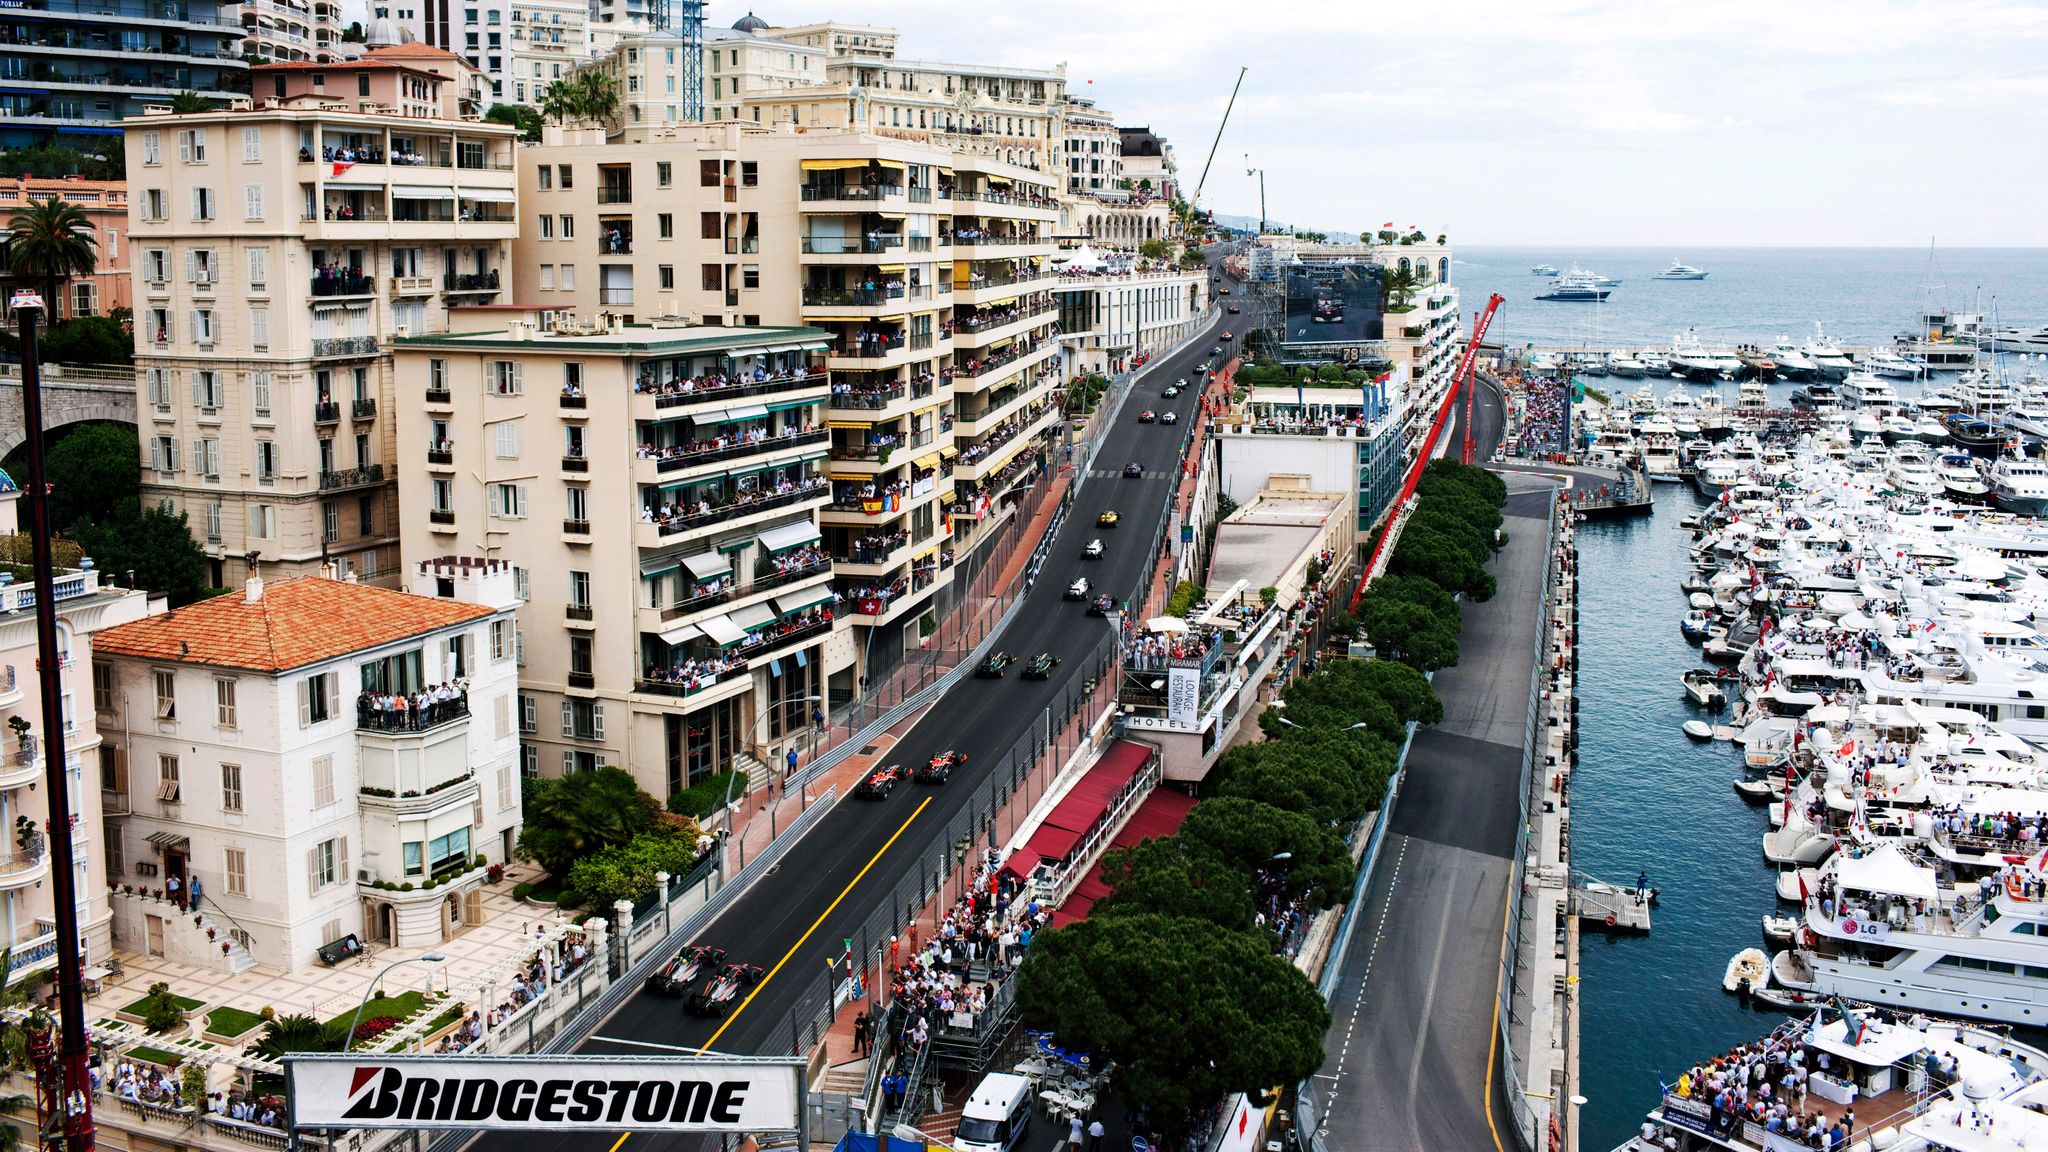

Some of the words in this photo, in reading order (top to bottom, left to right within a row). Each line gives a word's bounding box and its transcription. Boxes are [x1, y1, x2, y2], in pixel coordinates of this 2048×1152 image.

[1476, 310, 1493, 343] LEVAGE
[1343, 348, 1358, 361] 78
[1170, 659, 1200, 668] MIRAMAR
[1172, 674, 1184, 715] RESTAURANT
[1183, 679, 1195, 712] LOUNGE
[1133, 717, 1187, 729] HOTEL
[1860, 924, 1877, 934] LG
[341, 1066, 751, 1123] BRIDGESTONE
